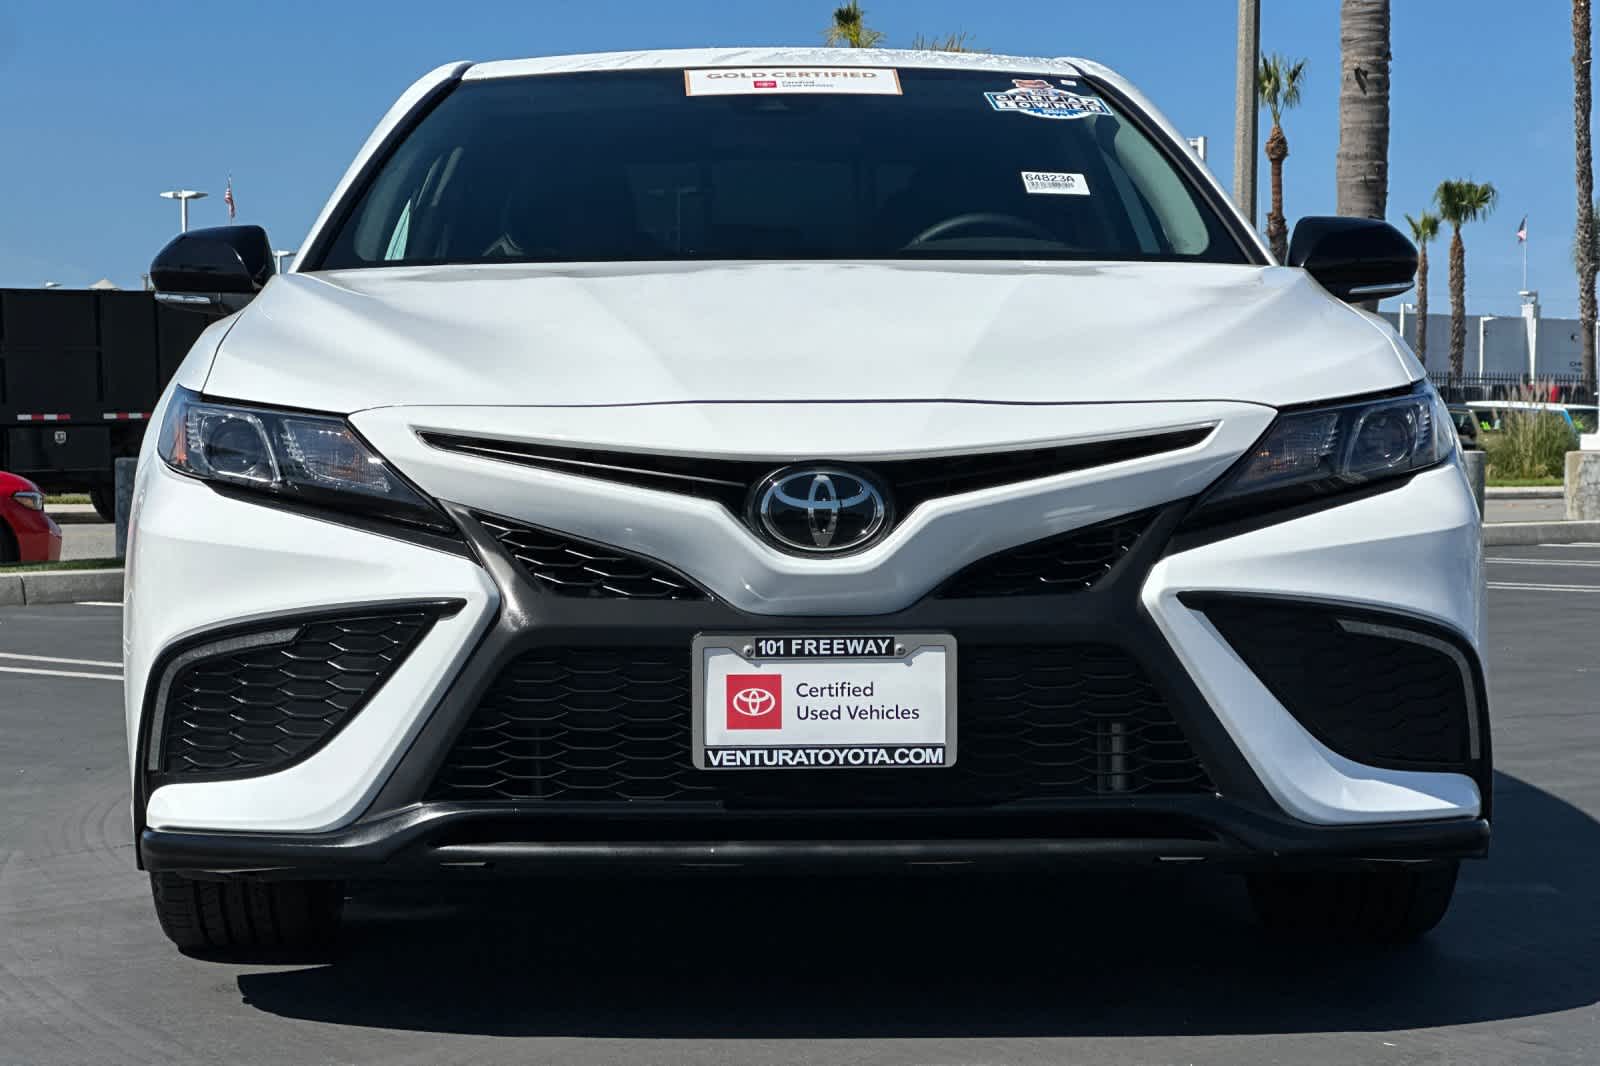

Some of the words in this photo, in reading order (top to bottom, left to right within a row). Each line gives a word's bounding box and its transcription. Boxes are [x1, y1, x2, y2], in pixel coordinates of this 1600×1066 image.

[771, 71, 877, 79] CERTIFIED
[1025, 173, 1075, 182] 64823A
[758, 639, 784, 655] 101
[791, 639, 890, 655] FREEWAY
[796, 681, 874, 698] Certified
[796, 705, 842, 720] Used
[847, 705, 920, 720] Vehicles
[707, 747, 944, 767] VENTURATOYOTA.COM
